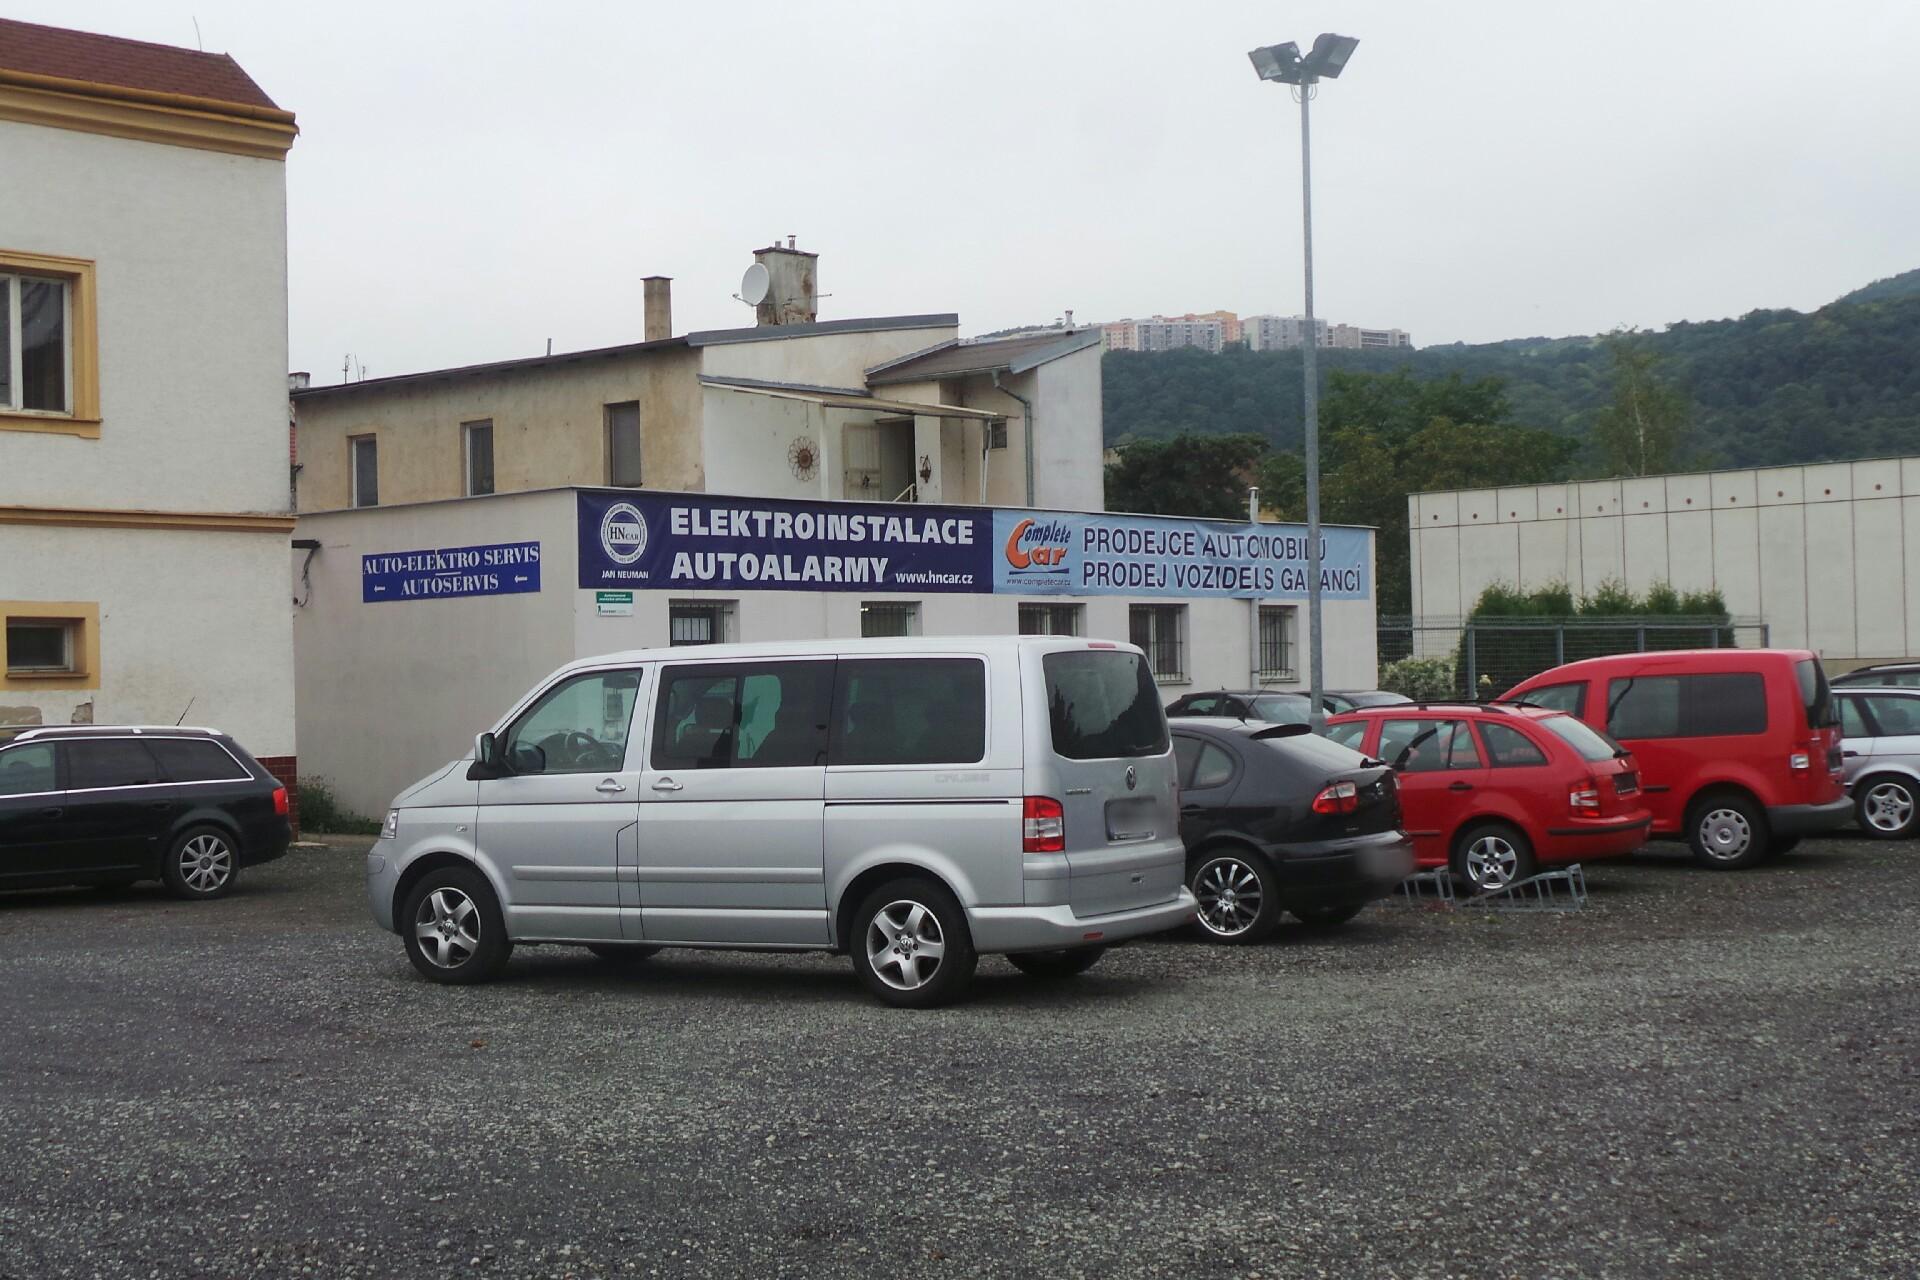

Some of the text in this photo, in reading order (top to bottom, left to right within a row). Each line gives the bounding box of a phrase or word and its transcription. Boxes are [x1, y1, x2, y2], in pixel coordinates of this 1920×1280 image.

[670, 507, 973, 545] ELEKTROINSTALACE
[1084, 528, 1195, 556] PRODEJCE
[363, 545, 539, 575] AUTO-ELEKTRO SERVIS
[601, 570, 649, 579] JAN NEUMAN
[670, 552, 973, 584] AUTOALARMY www.hncar.cz
[401, 574, 499, 596] AUTOSERVIS
[1083, 562, 1167, 588] PRODEJ
[1281, 564, 1361, 591] GAANCÍ
